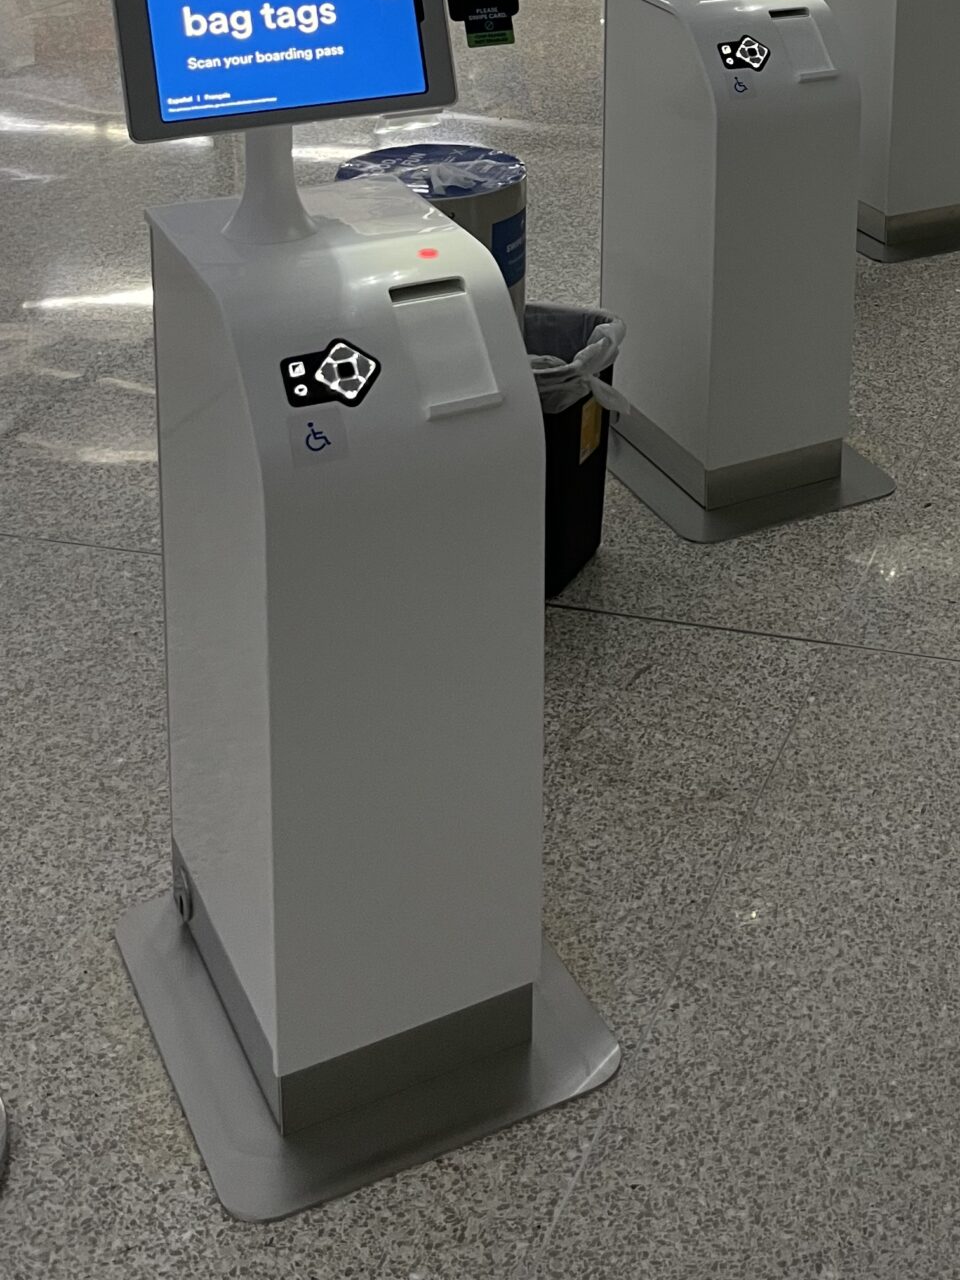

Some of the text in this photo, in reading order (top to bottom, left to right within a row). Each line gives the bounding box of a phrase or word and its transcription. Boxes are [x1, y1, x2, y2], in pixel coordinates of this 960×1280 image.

[182, 1, 337, 41] bag tags
[187, 44, 345, 70] Scan your boarding pass
